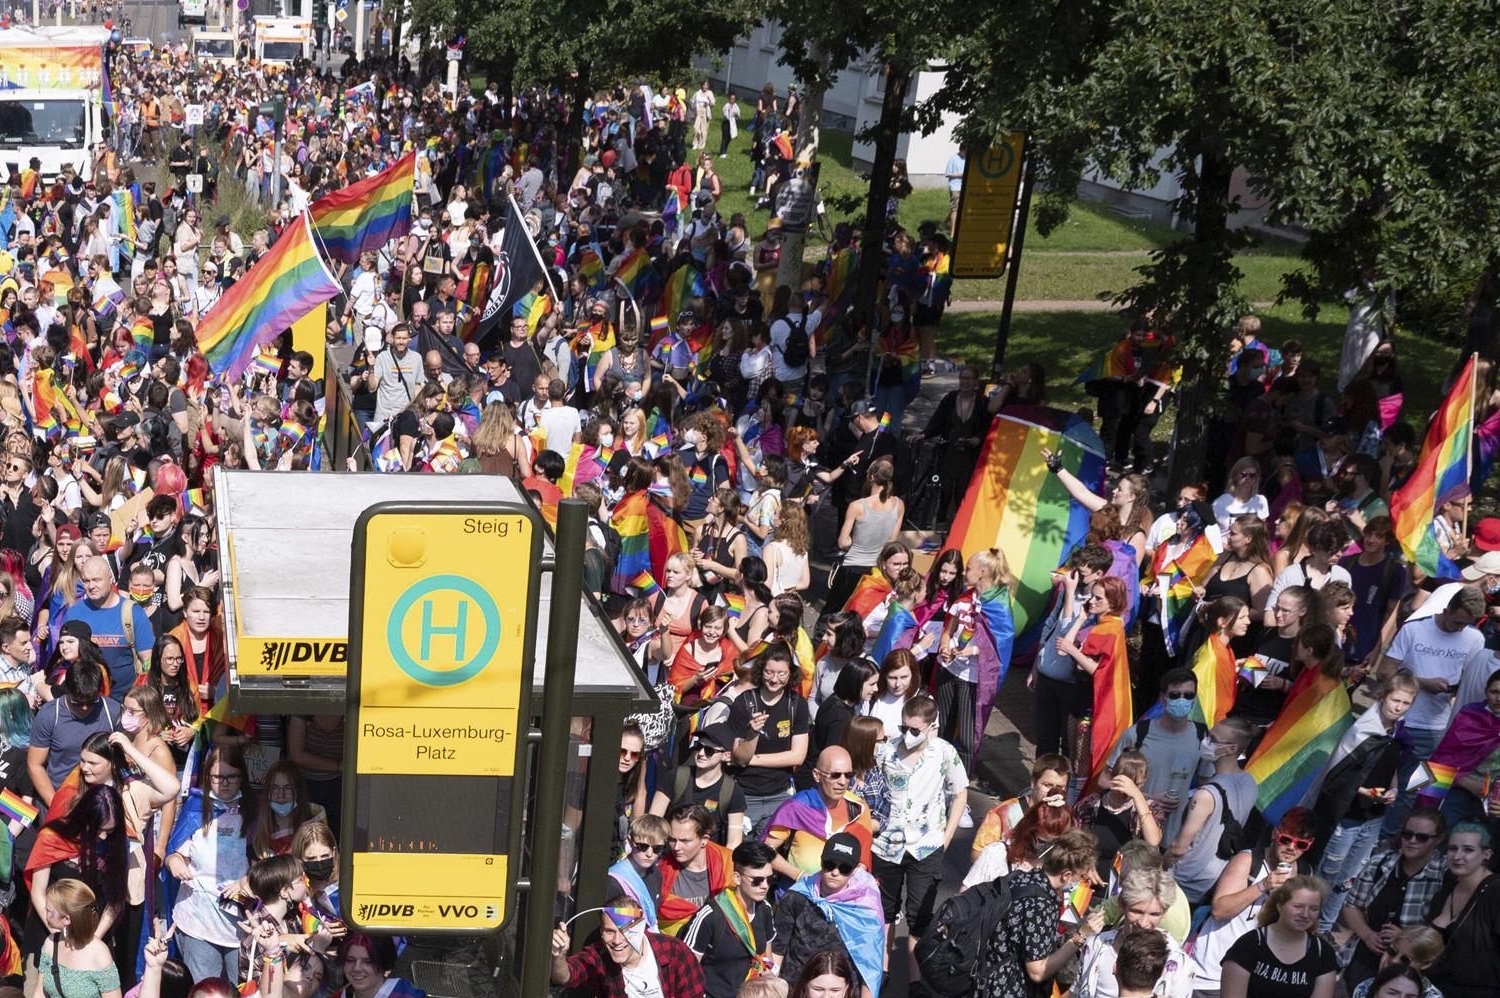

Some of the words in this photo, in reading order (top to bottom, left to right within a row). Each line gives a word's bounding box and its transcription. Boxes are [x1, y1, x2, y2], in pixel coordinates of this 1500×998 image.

[463, 518, 509, 538] Steig
[516, 519, 523, 534] 1
[420, 600, 467, 661] H
[291, 642, 348, 664] DVB
[363, 724, 512, 742] Rosa-Luxemburg-
[416, 745, 457, 760] Platz
[380, 904, 415, 917] DVB
[438, 905, 479, 918] VVO
[1271, 967, 1290, 984] BLA.
[1291, 972, 1308, 985] BLA.
